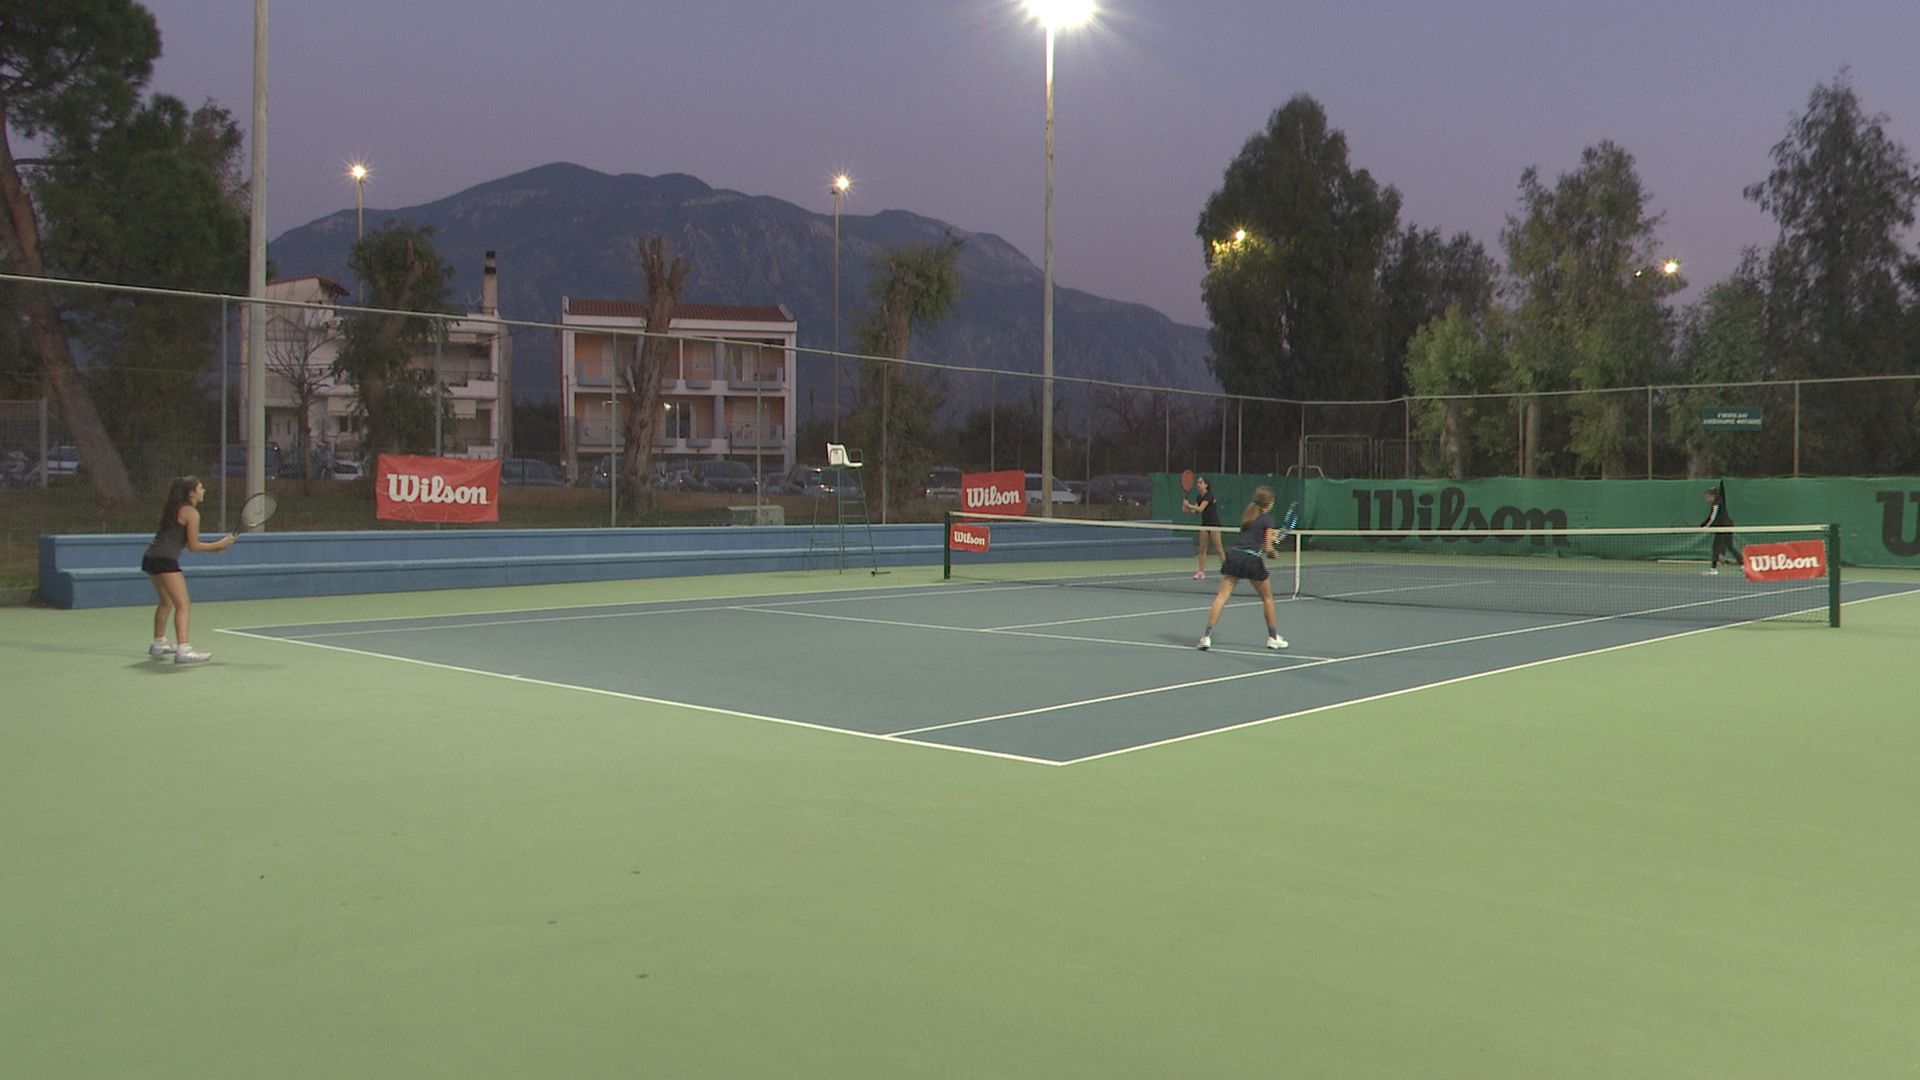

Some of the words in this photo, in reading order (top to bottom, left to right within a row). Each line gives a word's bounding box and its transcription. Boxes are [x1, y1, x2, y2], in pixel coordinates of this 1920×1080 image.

[387, 474, 489, 505] Wilson
[966, 486, 1020, 508] Wilson
[1352, 487, 1572, 547] Wilson
[954, 531, 985, 546] Wilson
[1749, 553, 1820, 572] Wilson
